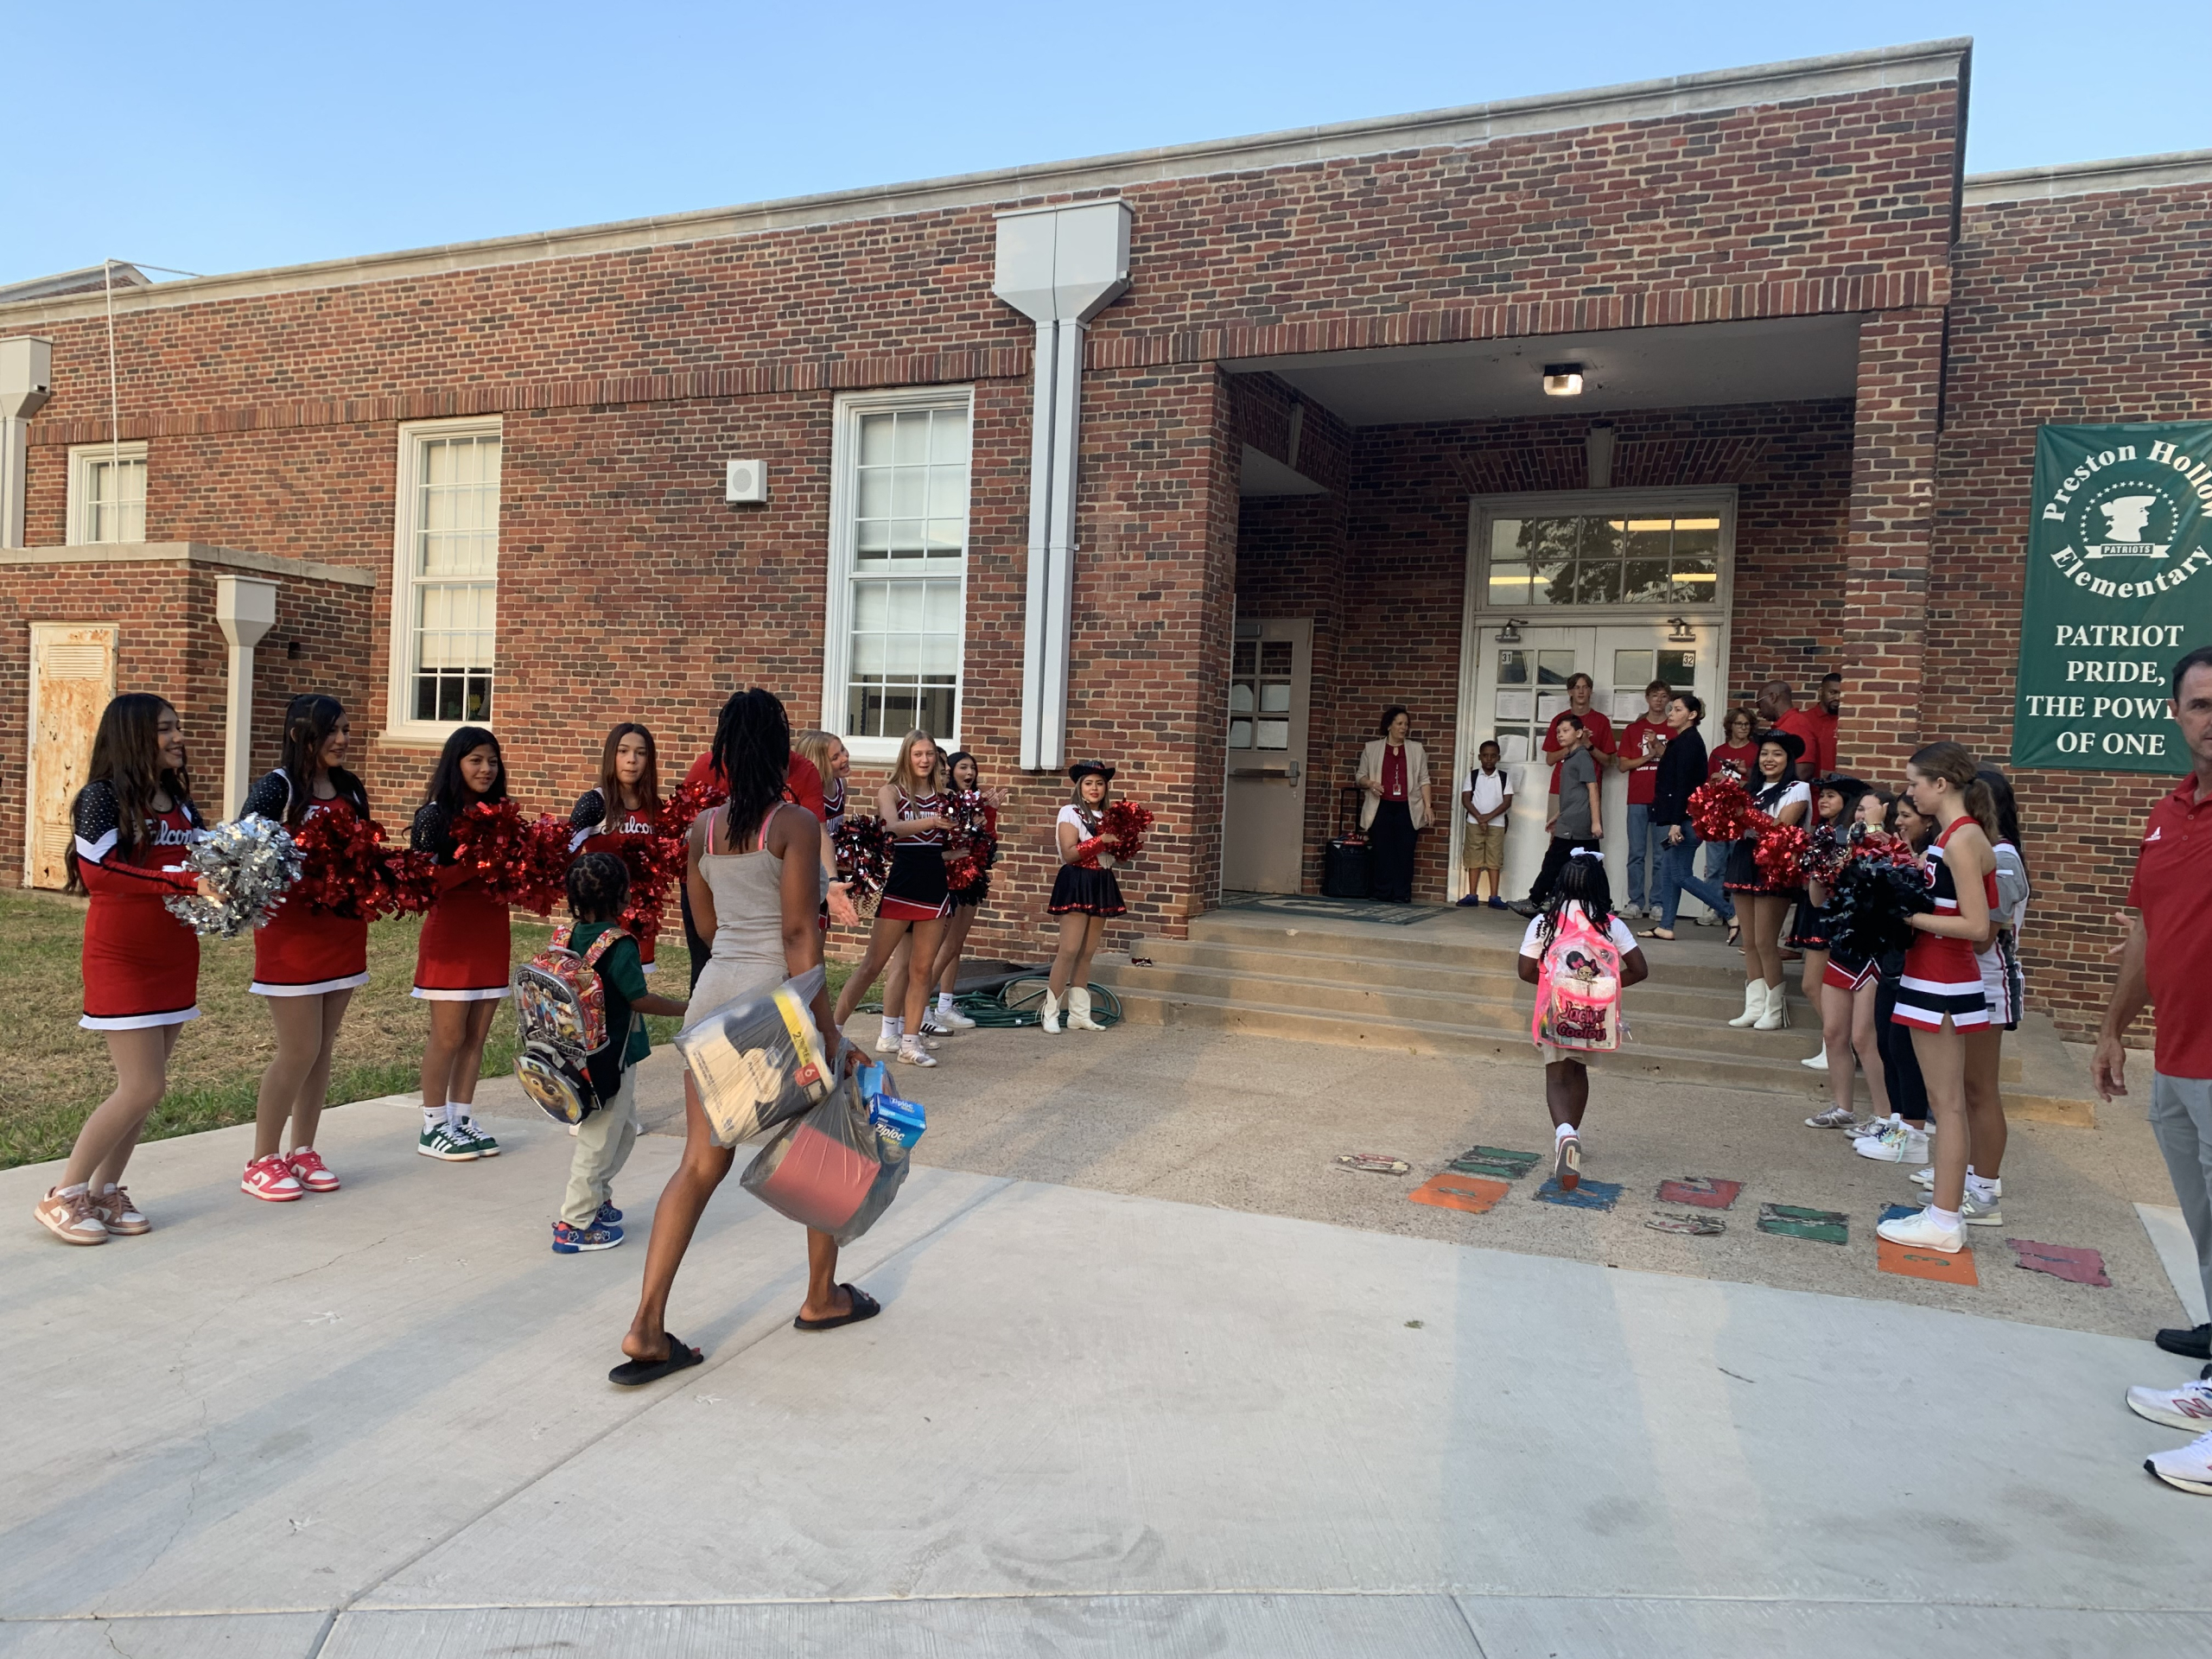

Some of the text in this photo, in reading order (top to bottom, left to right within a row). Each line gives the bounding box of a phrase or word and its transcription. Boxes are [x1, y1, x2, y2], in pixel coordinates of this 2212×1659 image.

[2043, 444, 2138, 523] Preston
[2104, 545, 2151, 554] PATRIOTS
[2050, 544, 2212, 599] Elementary
[2055, 625, 2184, 647] PATRIOT
[1502, 653, 1512, 663] 31
[1683, 655, 1694, 664] 32
[2066, 660, 2166, 687] PRIDE,
[2025, 695, 2175, 720] THE POW
[2056, 731, 2166, 756] OF ONE
[1556, 1022, 1607, 1042] Cooley
[804, 1068, 816, 1077] 6
[875, 1122, 906, 1141] Ziploc
